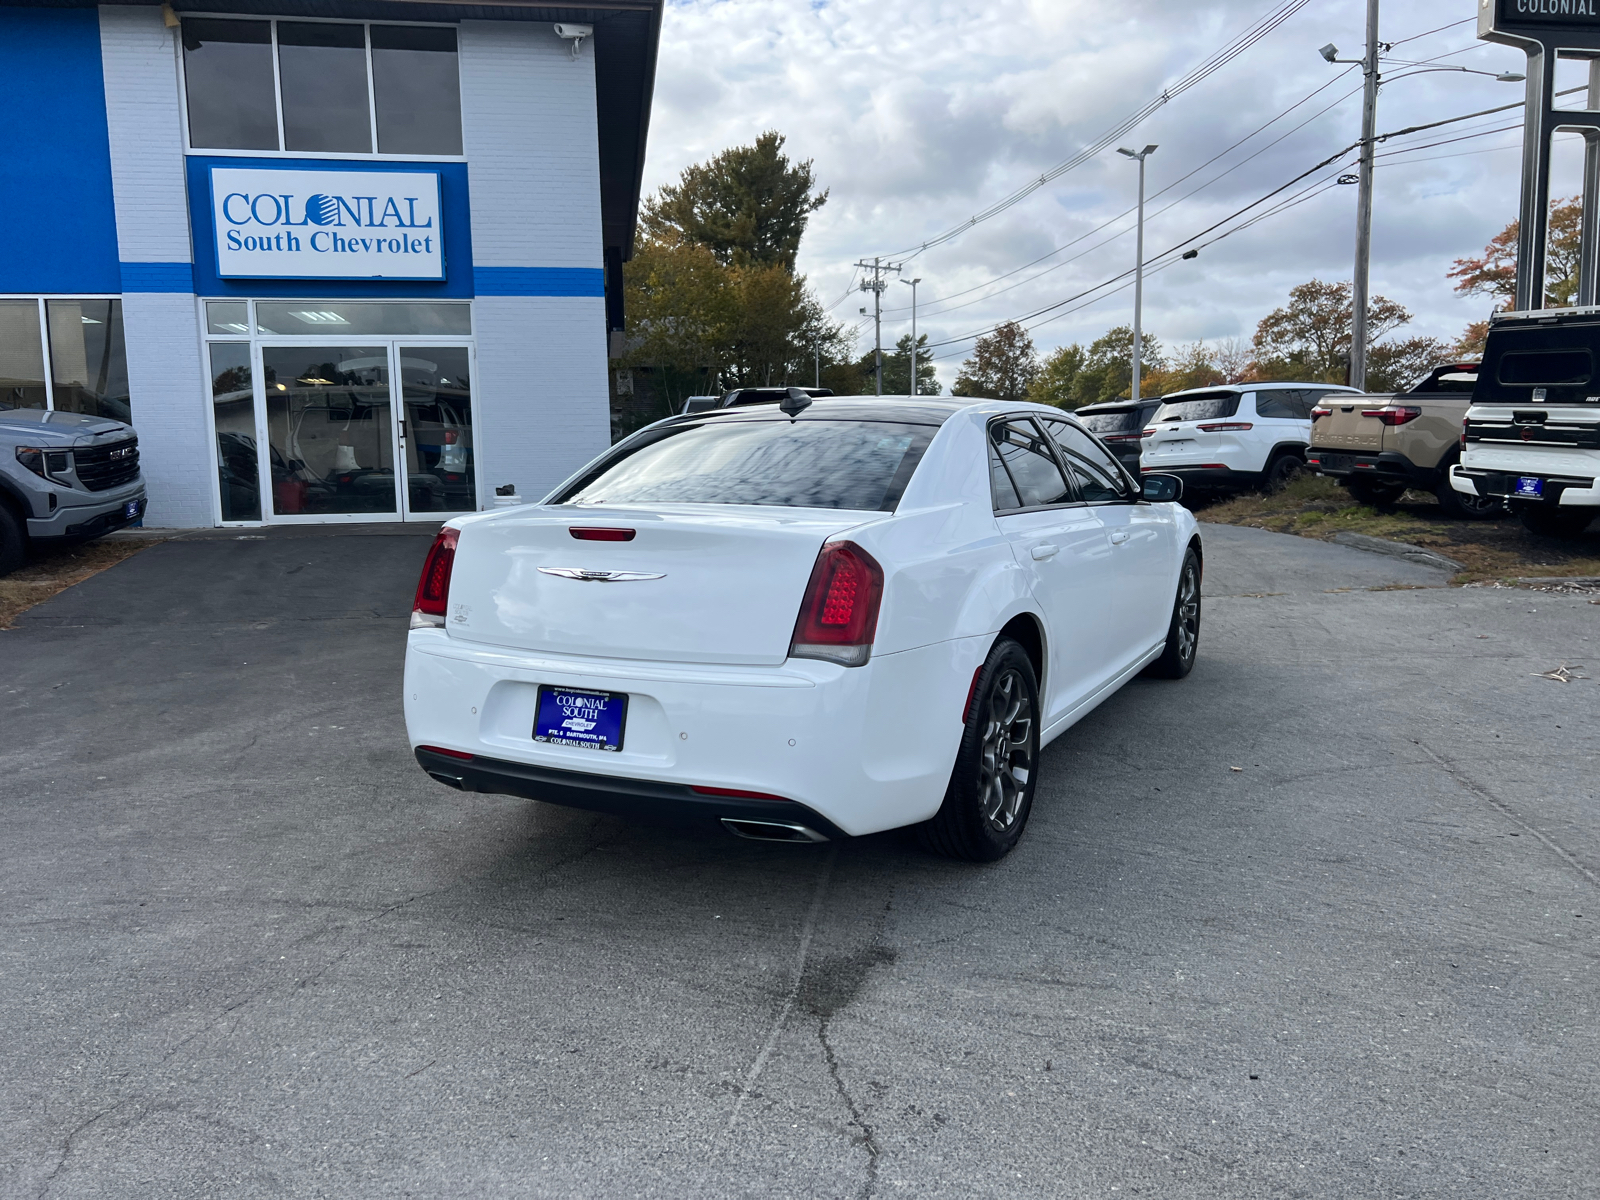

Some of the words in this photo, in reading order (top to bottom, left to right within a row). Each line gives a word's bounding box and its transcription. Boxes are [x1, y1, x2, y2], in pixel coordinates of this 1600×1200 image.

[1517, 0, 1597, 16] COLONIAL
[222, 192, 433, 229] COLONIAL
[226, 229, 302, 252] South
[310, 230, 433, 254] Chevrolet
[1314, 434, 1344, 443] SANTA
[1346, 436, 1378, 446] CRUZ
[556, 695, 608, 710] COLONIAL
[562, 706, 599, 719] SOUTH
[565, 720, 593, 729] CHEVROLET
[550, 737, 580, 747] COLONIAL
[580, 741, 600, 750] SOUTH
